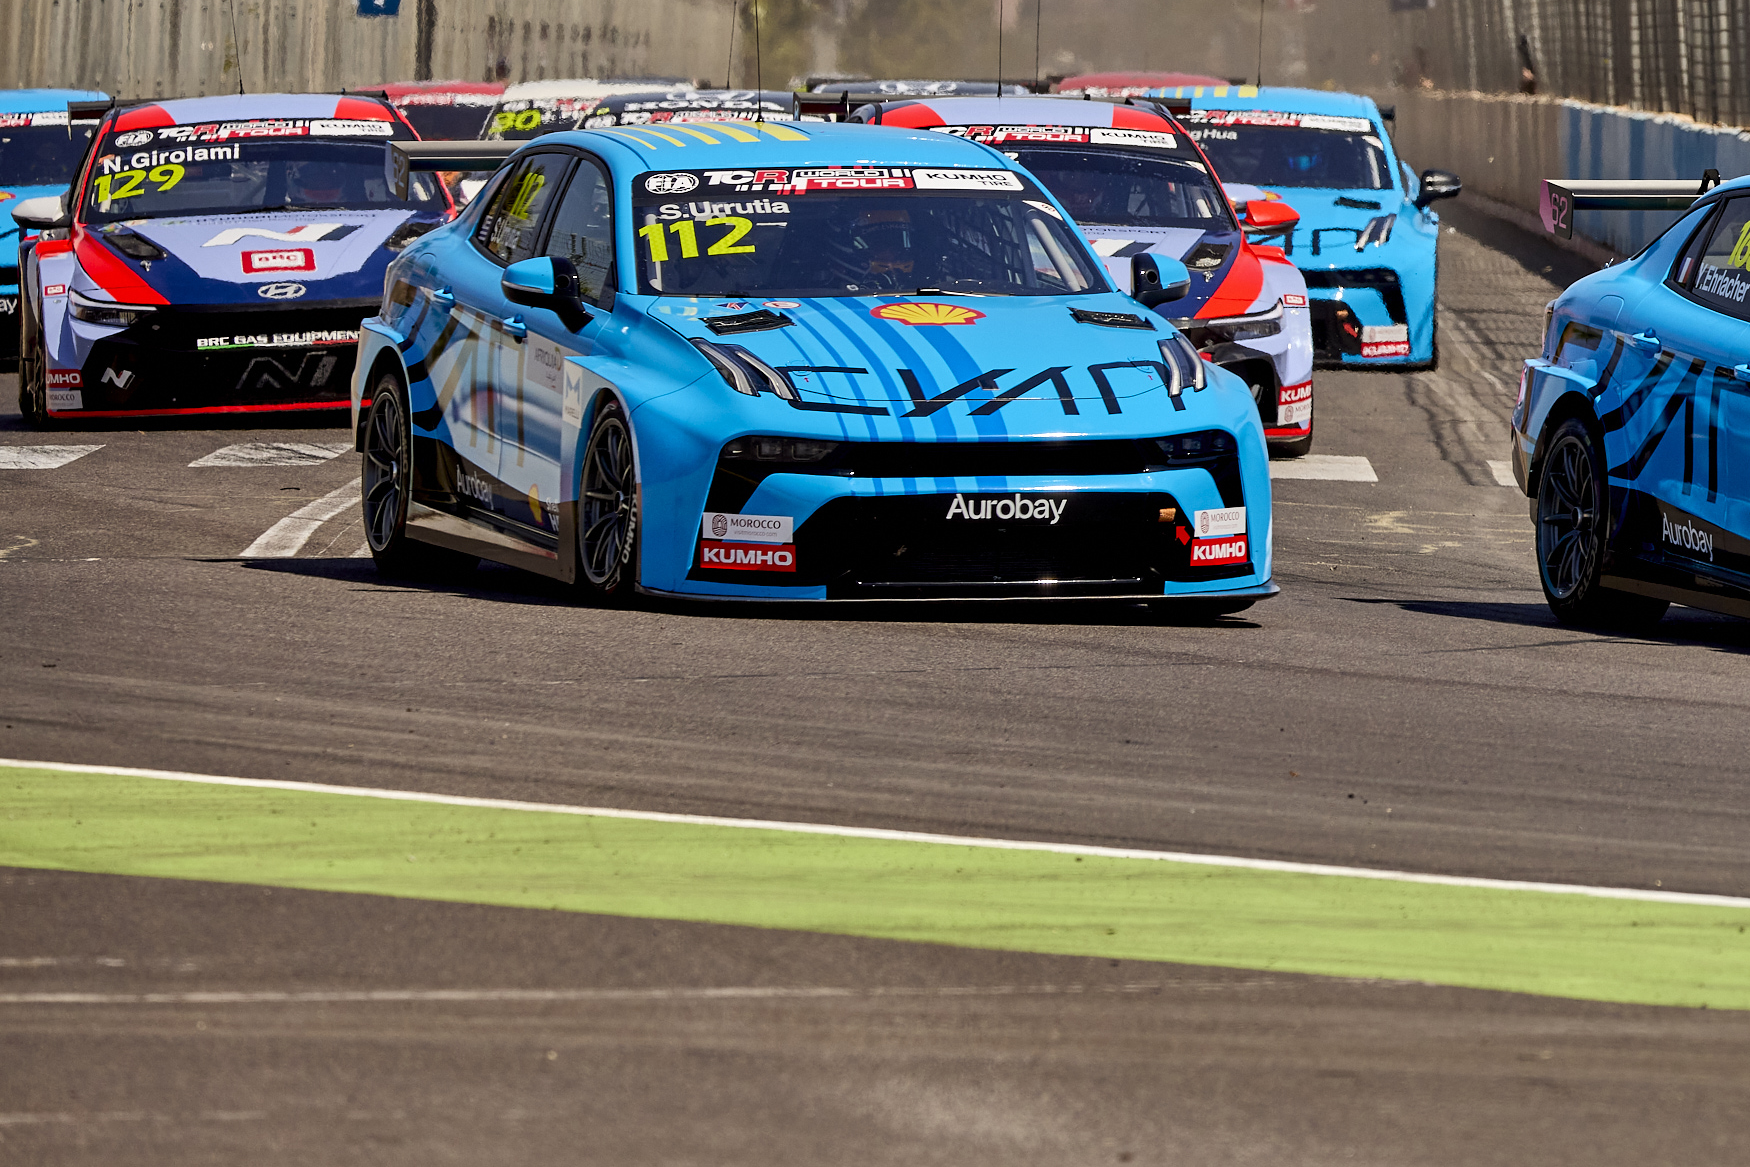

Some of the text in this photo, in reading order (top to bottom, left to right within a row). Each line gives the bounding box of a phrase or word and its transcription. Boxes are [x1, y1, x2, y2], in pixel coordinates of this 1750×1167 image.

[157, 125, 219, 140] TCR
[231, 127, 303, 137] TOUR
[319, 122, 383, 131] KUMHO
[1010, 134, 1083, 142] TOUR
[1100, 131, 1165, 141] KUMHO
[103, 143, 240, 175] N.Girolami
[703, 170, 789, 186] TCR
[813, 178, 906, 188] TOUR
[925, 172, 1007, 181] KUMHO
[94, 164, 186, 205] 129
[658, 198, 791, 220] S.Urrutia
[1551, 193, 1568, 229] 62
[638, 216, 756, 263] 112
[197, 336, 230, 347] BRC
[234, 334, 268, 344] GAS
[50, 393, 75, 402] OROCCO
[945, 493, 1067, 525] Aurobay
[1210, 511, 1240, 522] MOROCCO
[622, 494, 637, 564] KUMHO
[730, 518, 781, 530] MOROCCO
[1662, 512, 1713, 561] Aurobay
[703, 548, 793, 566] KUMHO
[1193, 541, 1246, 561] KUMHO
